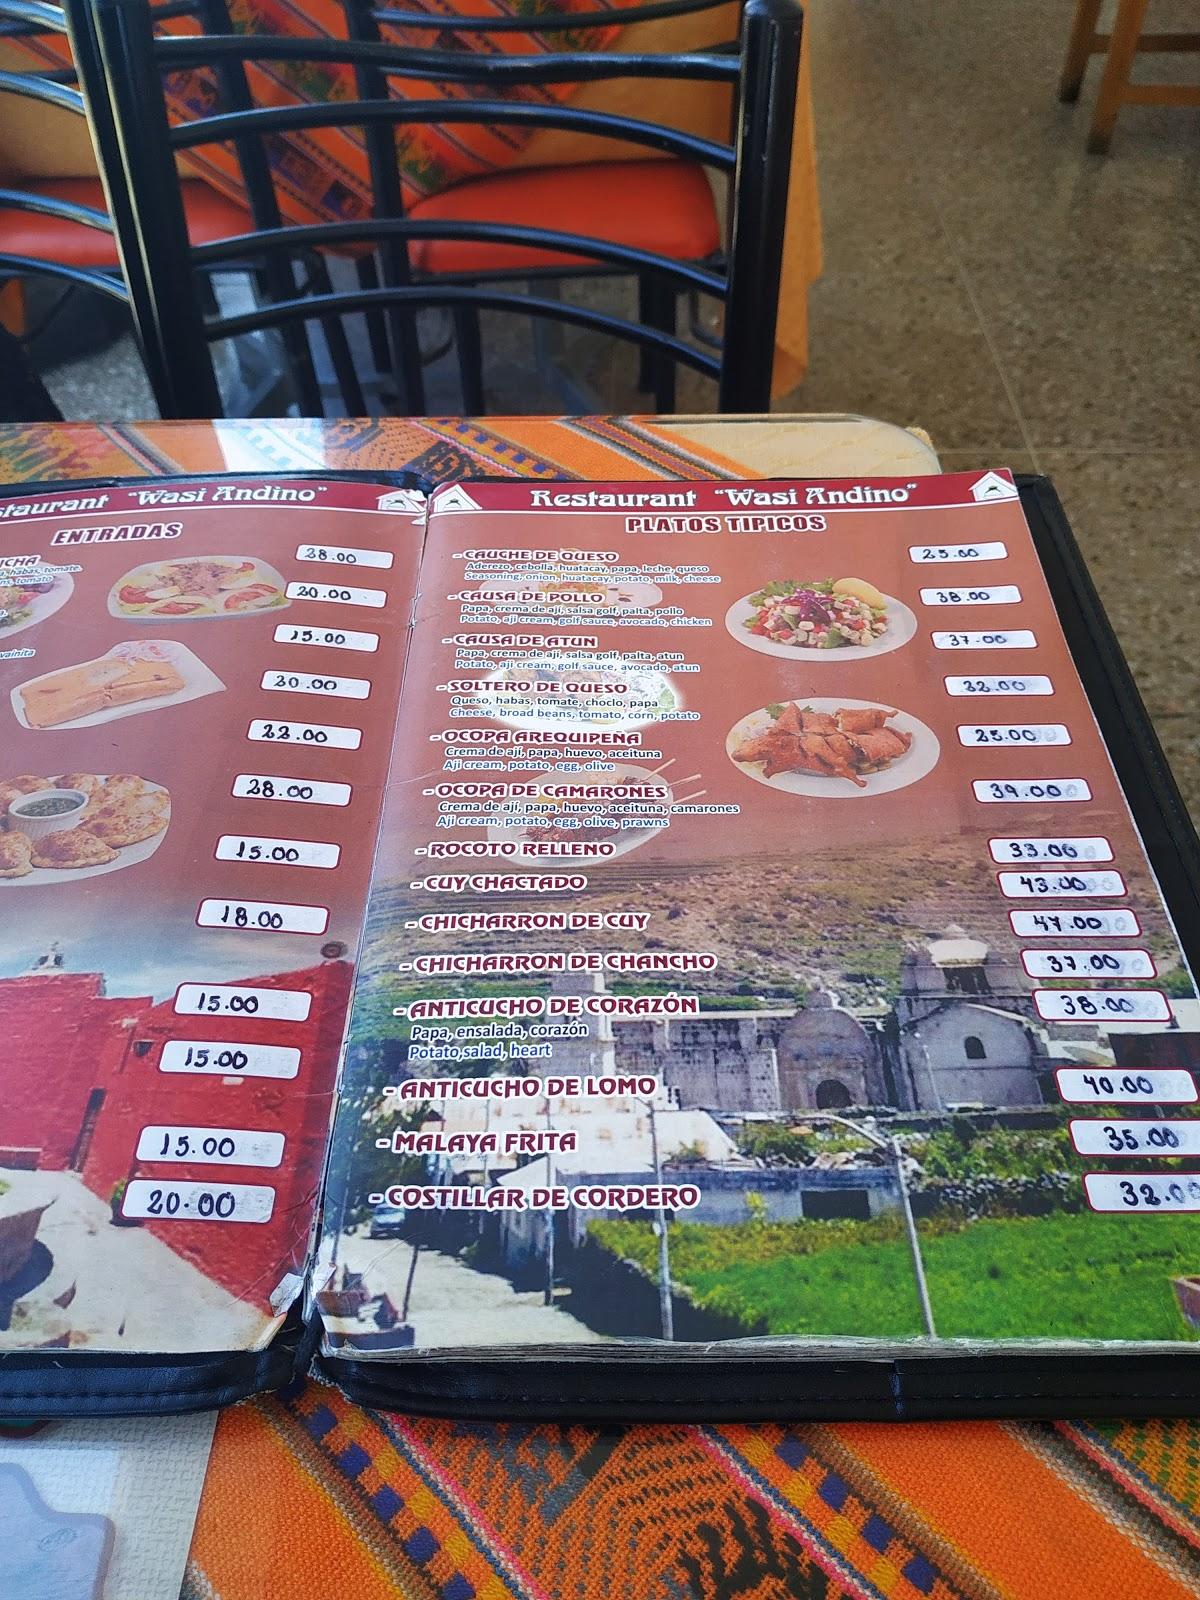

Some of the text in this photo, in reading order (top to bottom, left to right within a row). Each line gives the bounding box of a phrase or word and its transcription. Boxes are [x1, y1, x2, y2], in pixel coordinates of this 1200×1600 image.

[530, 483, 918, 507] Restaurant “Wasi Andino”
[625, 514, 827, 533] PLATOS TIPICOS
[51, 522, 183, 546] ENTRADAS
[533, 550, 557, 560] DE
[561, 551, 618, 562] QUESO
[923, 548, 979, 559] 25.00
[466, 563, 513, 571] Aderezo,
[515, 563, 556, 571] cebolla,
[559, 564, 609, 573] huatacay,
[643, 565, 674, 573] leche,
[296, 586, 351, 601] 20.00
[521, 592, 545, 601] DE
[549, 593, 604, 602] POLLO
[937, 591, 990, 602] 38.00
[462, 605, 492, 613] Papa,
[596, 607, 619, 616] golf,
[622, 607, 653, 616] palta,
[655, 608, 684, 616] pollo
[503, 616, 517, 624] aji
[582, 618, 617, 626] sauce,
[620, 618, 669, 626] avocado,
[670, 618, 712, 626] chicken
[290, 630, 345, 645] 15.00
[517, 635, 543, 645] DE
[546, 636, 597, 647] ATUN
[949, 634, 1007, 646] 37.00
[457, 649, 488, 658] Papa,
[529, 650, 543, 658] de
[566, 651, 593, 659] salsa
[596, 652, 620, 660] golf,
[622, 652, 655, 661] palta,
[456, 661, 496, 669] Potato,
[500, 661, 514, 669] aji
[516, 662, 555, 670] cream,
[557, 662, 580, 671] golf
[620, 664, 671, 672] avocado,
[673, 664, 700, 672] atun
[536, 682, 560, 693] DE
[565, 683, 628, 694] QUESO
[451, 697, 658, 709] Queso, habas, tomate, choclo, papa
[450, 709, 496, 717] Cheese,
[500, 709, 534, 717] broad
[537, 709, 575, 718] beans,
[579, 711, 625, 719] tomato,
[661, 713, 700, 721] potato
[262, 719, 328, 744] 22.00
[514, 731, 640, 745] AREQUIPEÑA
[446, 747, 485, 756] Crema
[488, 747, 504, 756] de
[528, 749, 562, 758] papa,
[565, 749, 606, 758] huevo,
[608, 749, 661, 758] aceituna
[444, 760, 615, 772] Aji cream, potato, egg, olive
[246, 778, 313, 800] 28.00
[511, 785, 538, 796] DE
[543, 786, 667, 798] CAMARONES
[439, 802, 480, 811] Crema
[484, 802, 499, 811] de
[525, 804, 560, 813] papa,
[563, 803, 605, 813] huevo,
[609, 804, 667, 814] aceituna,
[670, 805, 739, 813] camarones
[437, 816, 669, 828] Aji cream, potato, egg, olive, prawns
[235, 841, 299, 862] 15.00
[521, 843, 615, 857] RELLENO
[1009, 843, 1078, 858] 33.00
[471, 875, 587, 891] CHACTADO
[1020, 875, 1087, 893] 43.00
[220, 905, 283, 929] 18.00
[571, 913, 603, 929] DE
[606, 912, 651, 931] CUY
[1033, 915, 1102, 932] 47.00
[569, 953, 601, 971] DE
[606, 953, 718, 972] CHANCHO
[1047, 954, 1120, 972] 37.00
[197, 992, 258, 1013] 15.00
[548, 997, 583, 1015] DE
[586, 993, 699, 1015] CORAZÓN
[1060, 994, 1134, 1015] 38.00
[411, 1023, 589, 1041] Papa, ensalada, corazón
[511, 1043, 553, 1058] heart
[184, 1047, 248, 1070] 15.00
[546, 1077, 582, 1097] DE
[587, 1077, 658, 1096] LOMO
[1083, 1074, 1154, 1095] 40.00
[160, 1133, 235, 1158] 15.00
[504, 1131, 578, 1154] FRITA
[1103, 1126, 1180, 1151] 35.00
[147, 1189, 235, 1217] 20.00
[533, 1187, 567, 1209] DE
[571, 1187, 701, 1209] CORDERO
